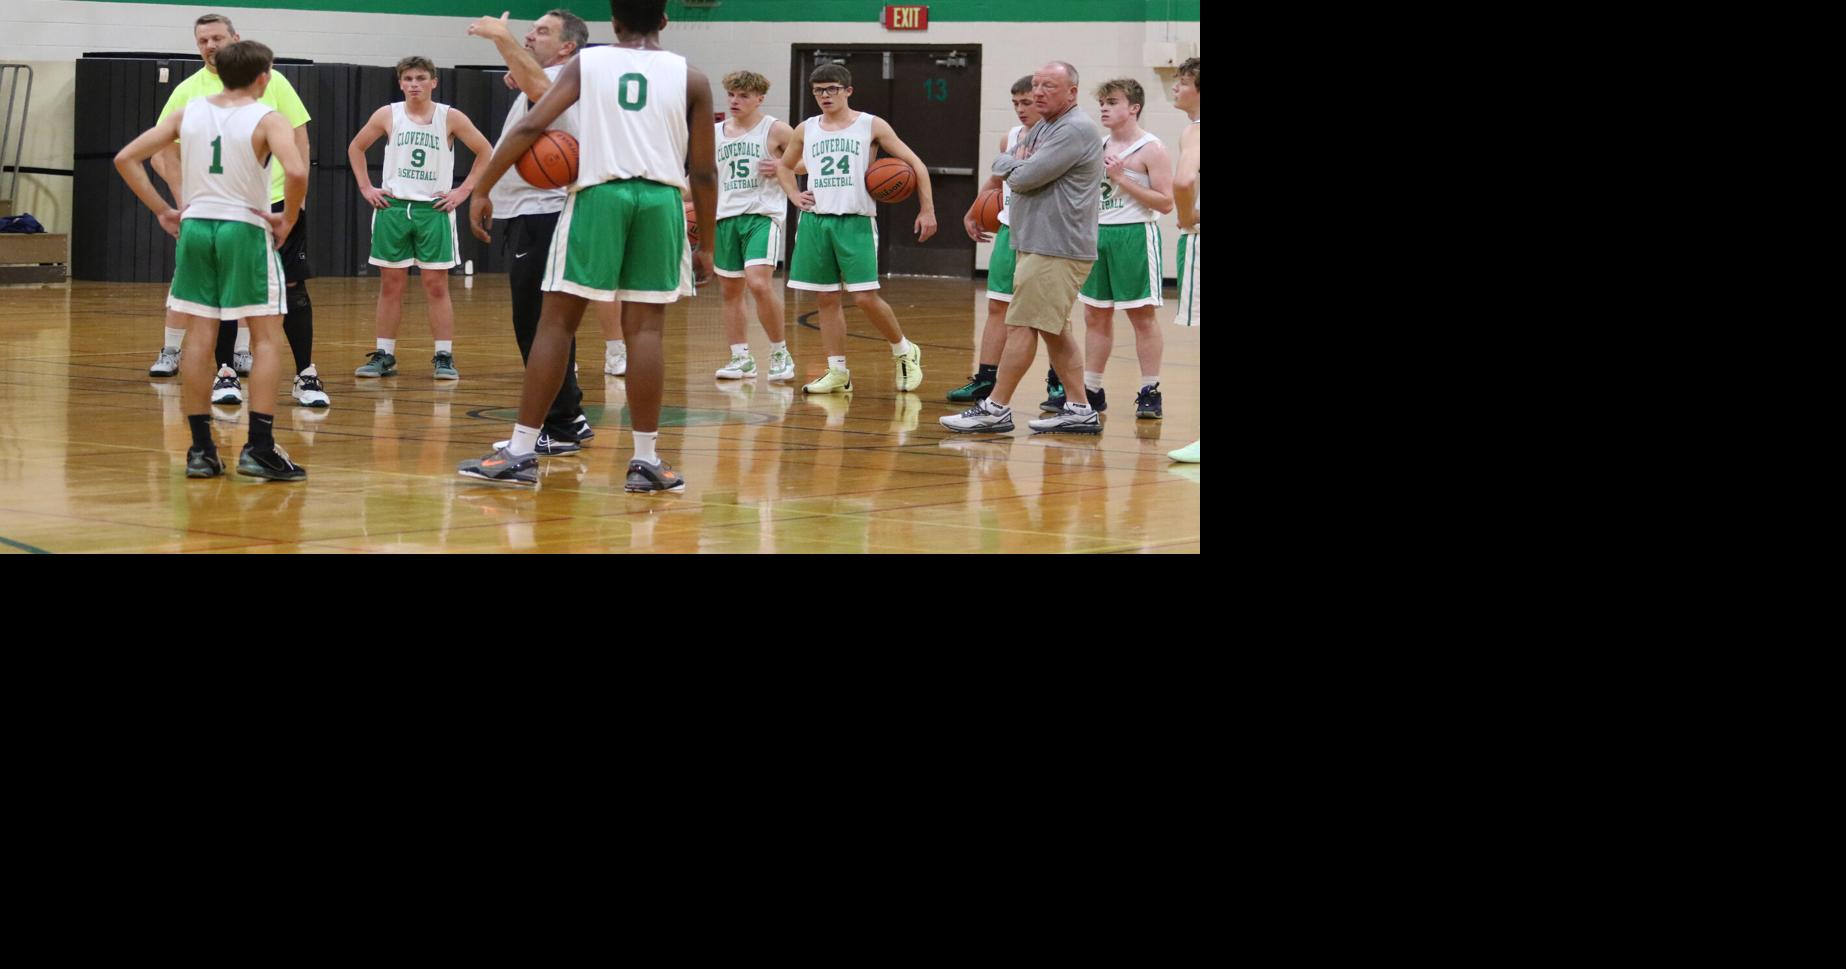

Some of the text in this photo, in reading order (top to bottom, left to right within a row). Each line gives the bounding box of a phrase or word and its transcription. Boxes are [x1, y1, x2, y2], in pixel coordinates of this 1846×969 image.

[893, 7, 920, 28] EXIT
[618, 73, 648, 111] 0
[923, 79, 948, 102] 13
[208, 135, 224, 174] 1
[410, 148, 426, 168] 9
[717, 142, 760, 162] CLOVERDALE
[811, 138, 860, 158] CLOVERDALE
[728, 158, 750, 180] 15
[820, 154, 850, 176] 24
[814, 176, 854, 188] BASKETBAL
